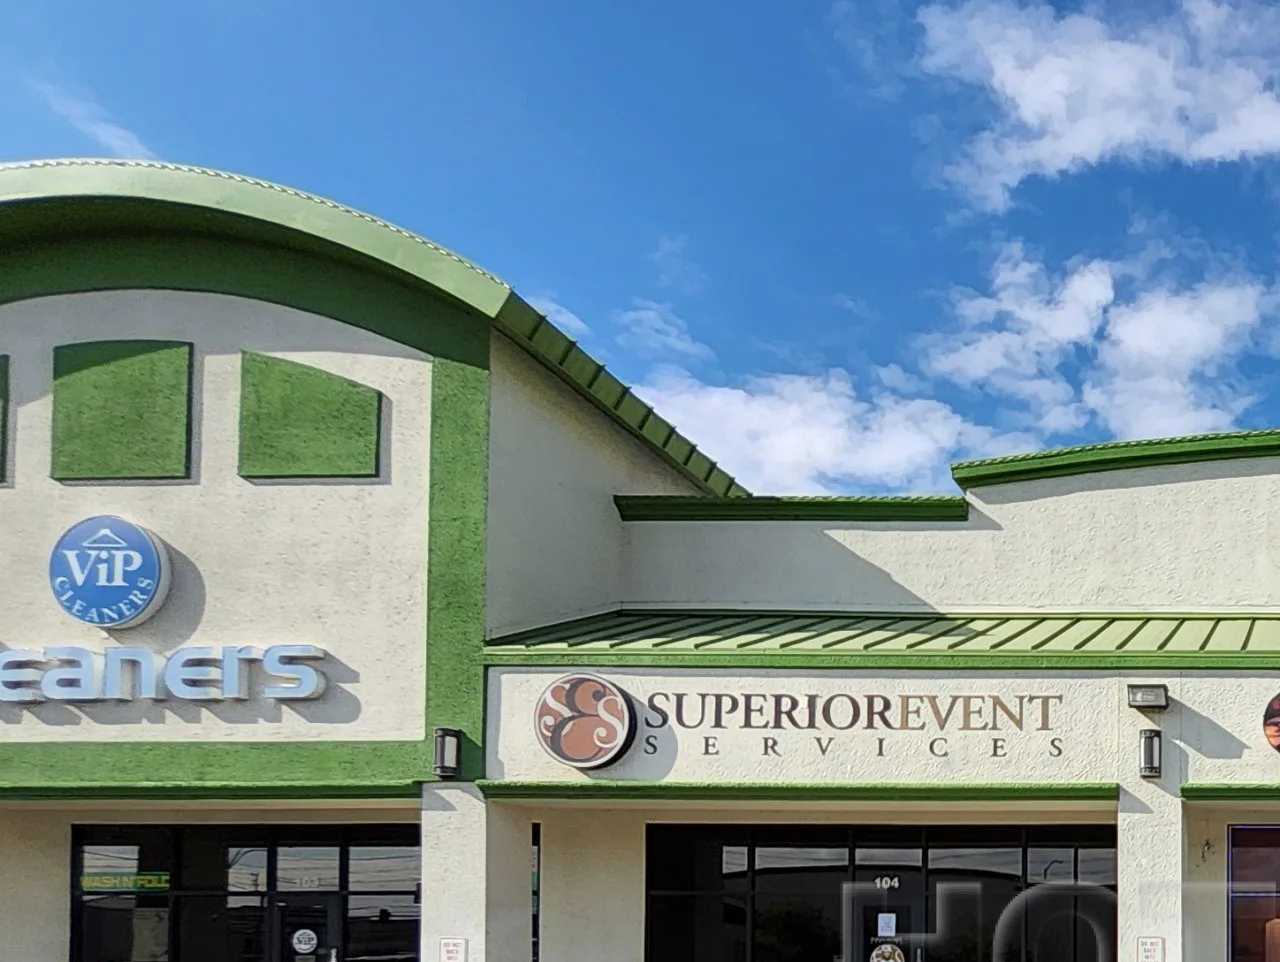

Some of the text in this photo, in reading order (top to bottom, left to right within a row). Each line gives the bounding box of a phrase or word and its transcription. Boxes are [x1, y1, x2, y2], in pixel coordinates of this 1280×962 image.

[54, 575, 155, 625] CLEANERS
[643, 735, 1064, 758] SERVICES
[873, 876, 900, 889] 104
